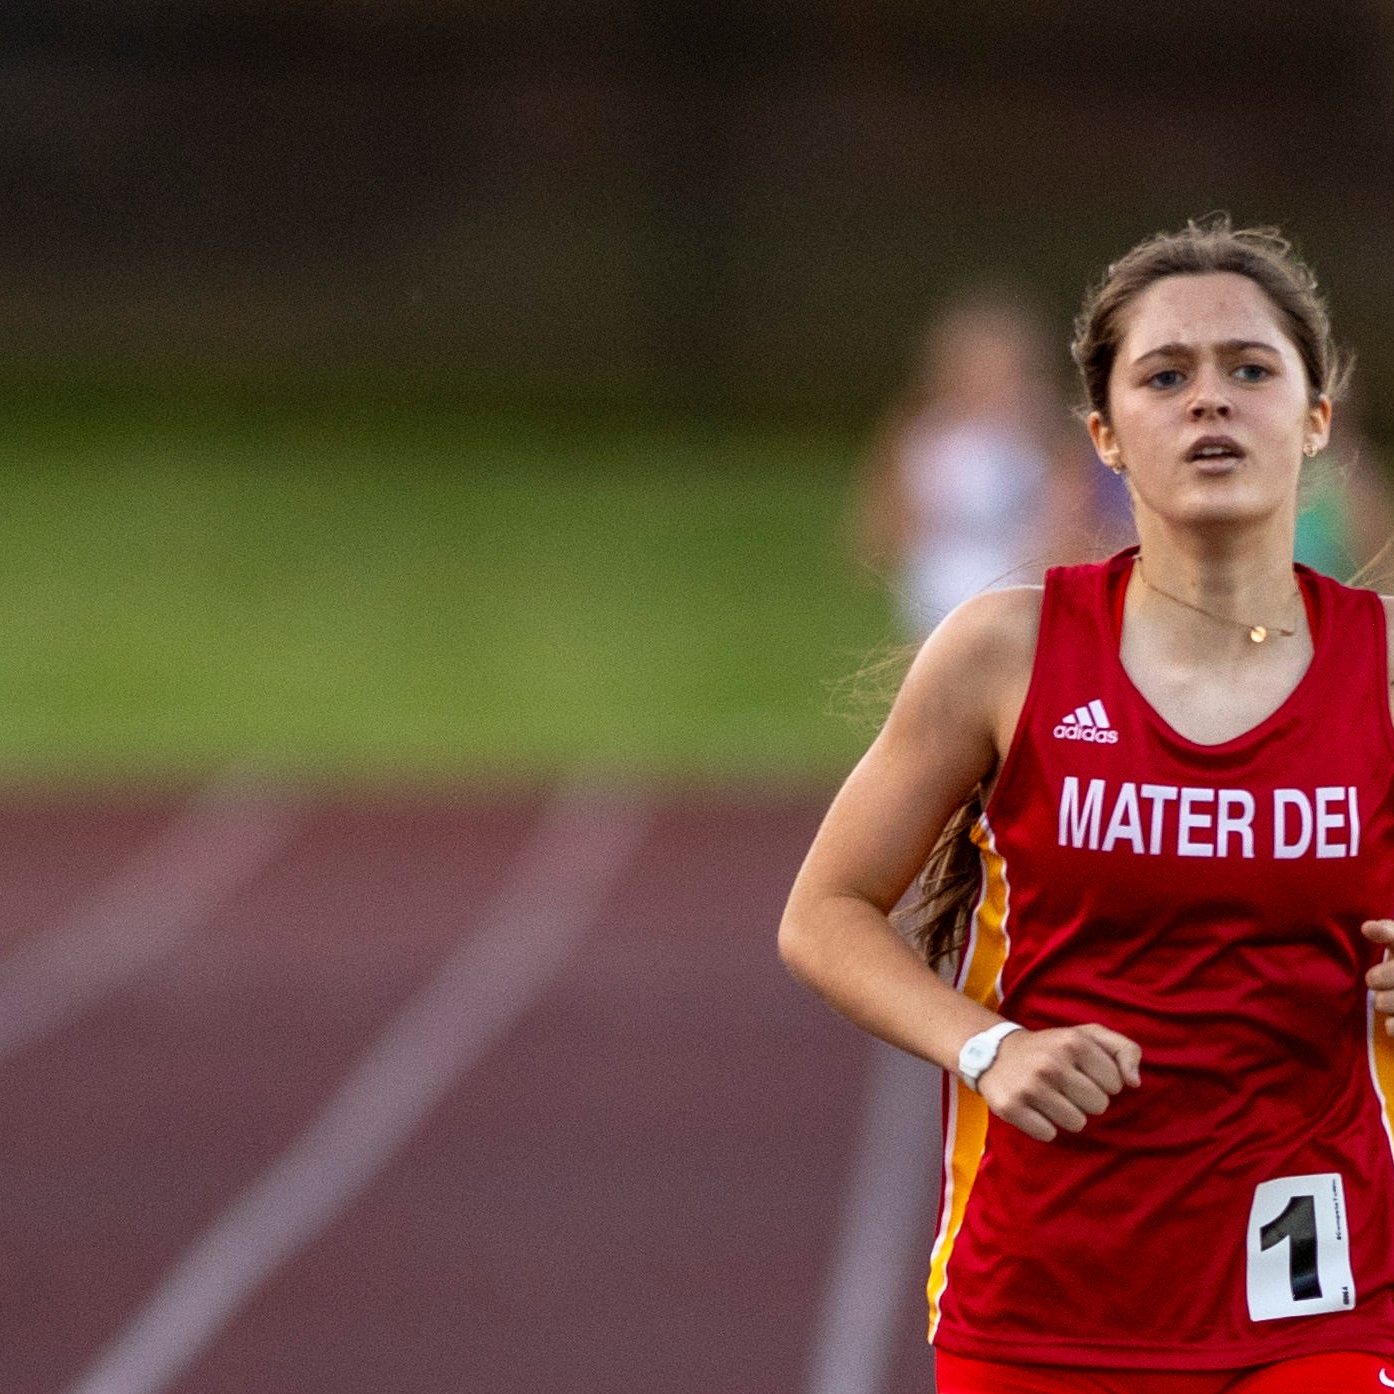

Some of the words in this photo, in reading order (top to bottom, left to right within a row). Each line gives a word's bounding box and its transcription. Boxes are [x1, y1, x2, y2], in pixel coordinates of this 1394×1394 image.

[1053, 724, 1119, 744] adidas
[1058, 776, 1255, 859] MATER
[1273, 786, 1360, 859] DEI
[1259, 1195, 1323, 1301] 1
